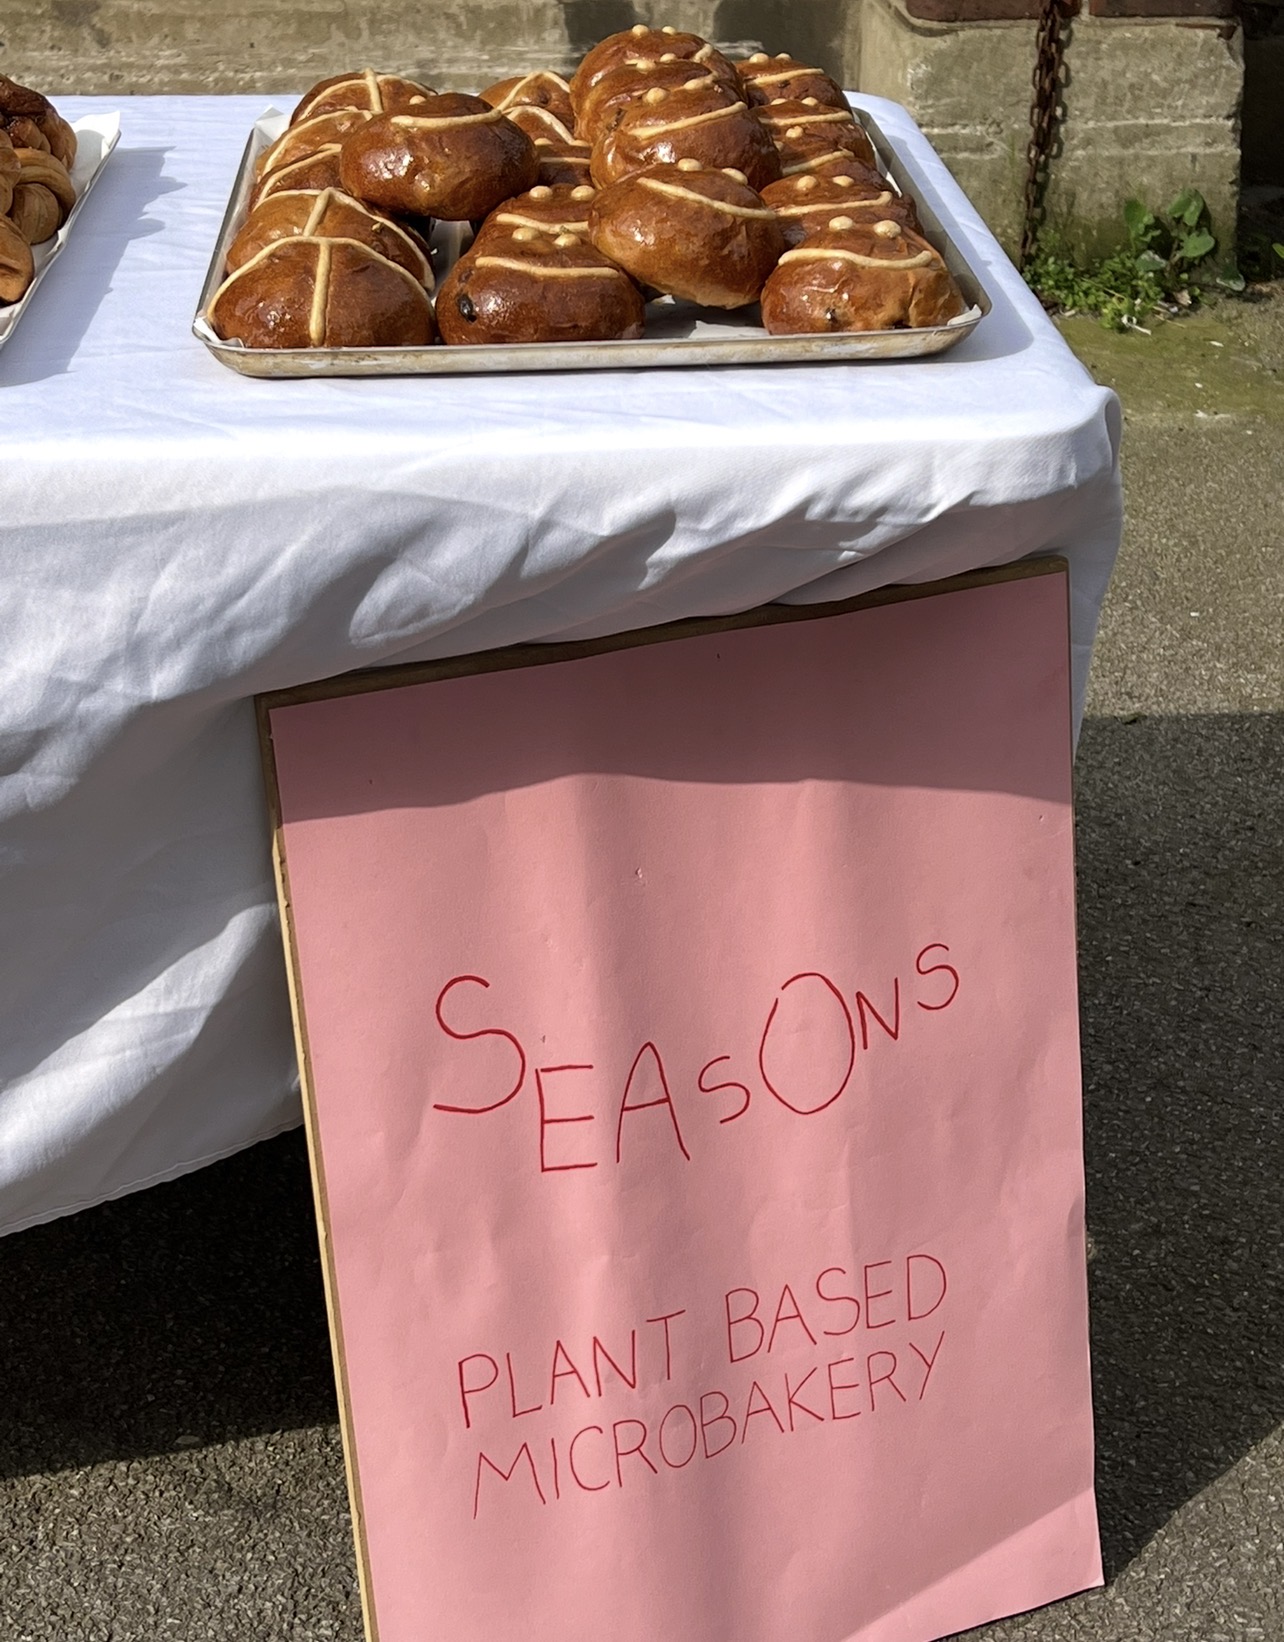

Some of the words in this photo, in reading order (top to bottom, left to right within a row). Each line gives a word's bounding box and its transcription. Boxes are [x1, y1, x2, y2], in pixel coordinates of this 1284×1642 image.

[432, 942, 960, 1174] SEASONS
[457, 1309, 687, 1430] PLANT
[724, 1254, 947, 1364] BASED
[473, 1330, 946, 1520] MICROBAKERY
